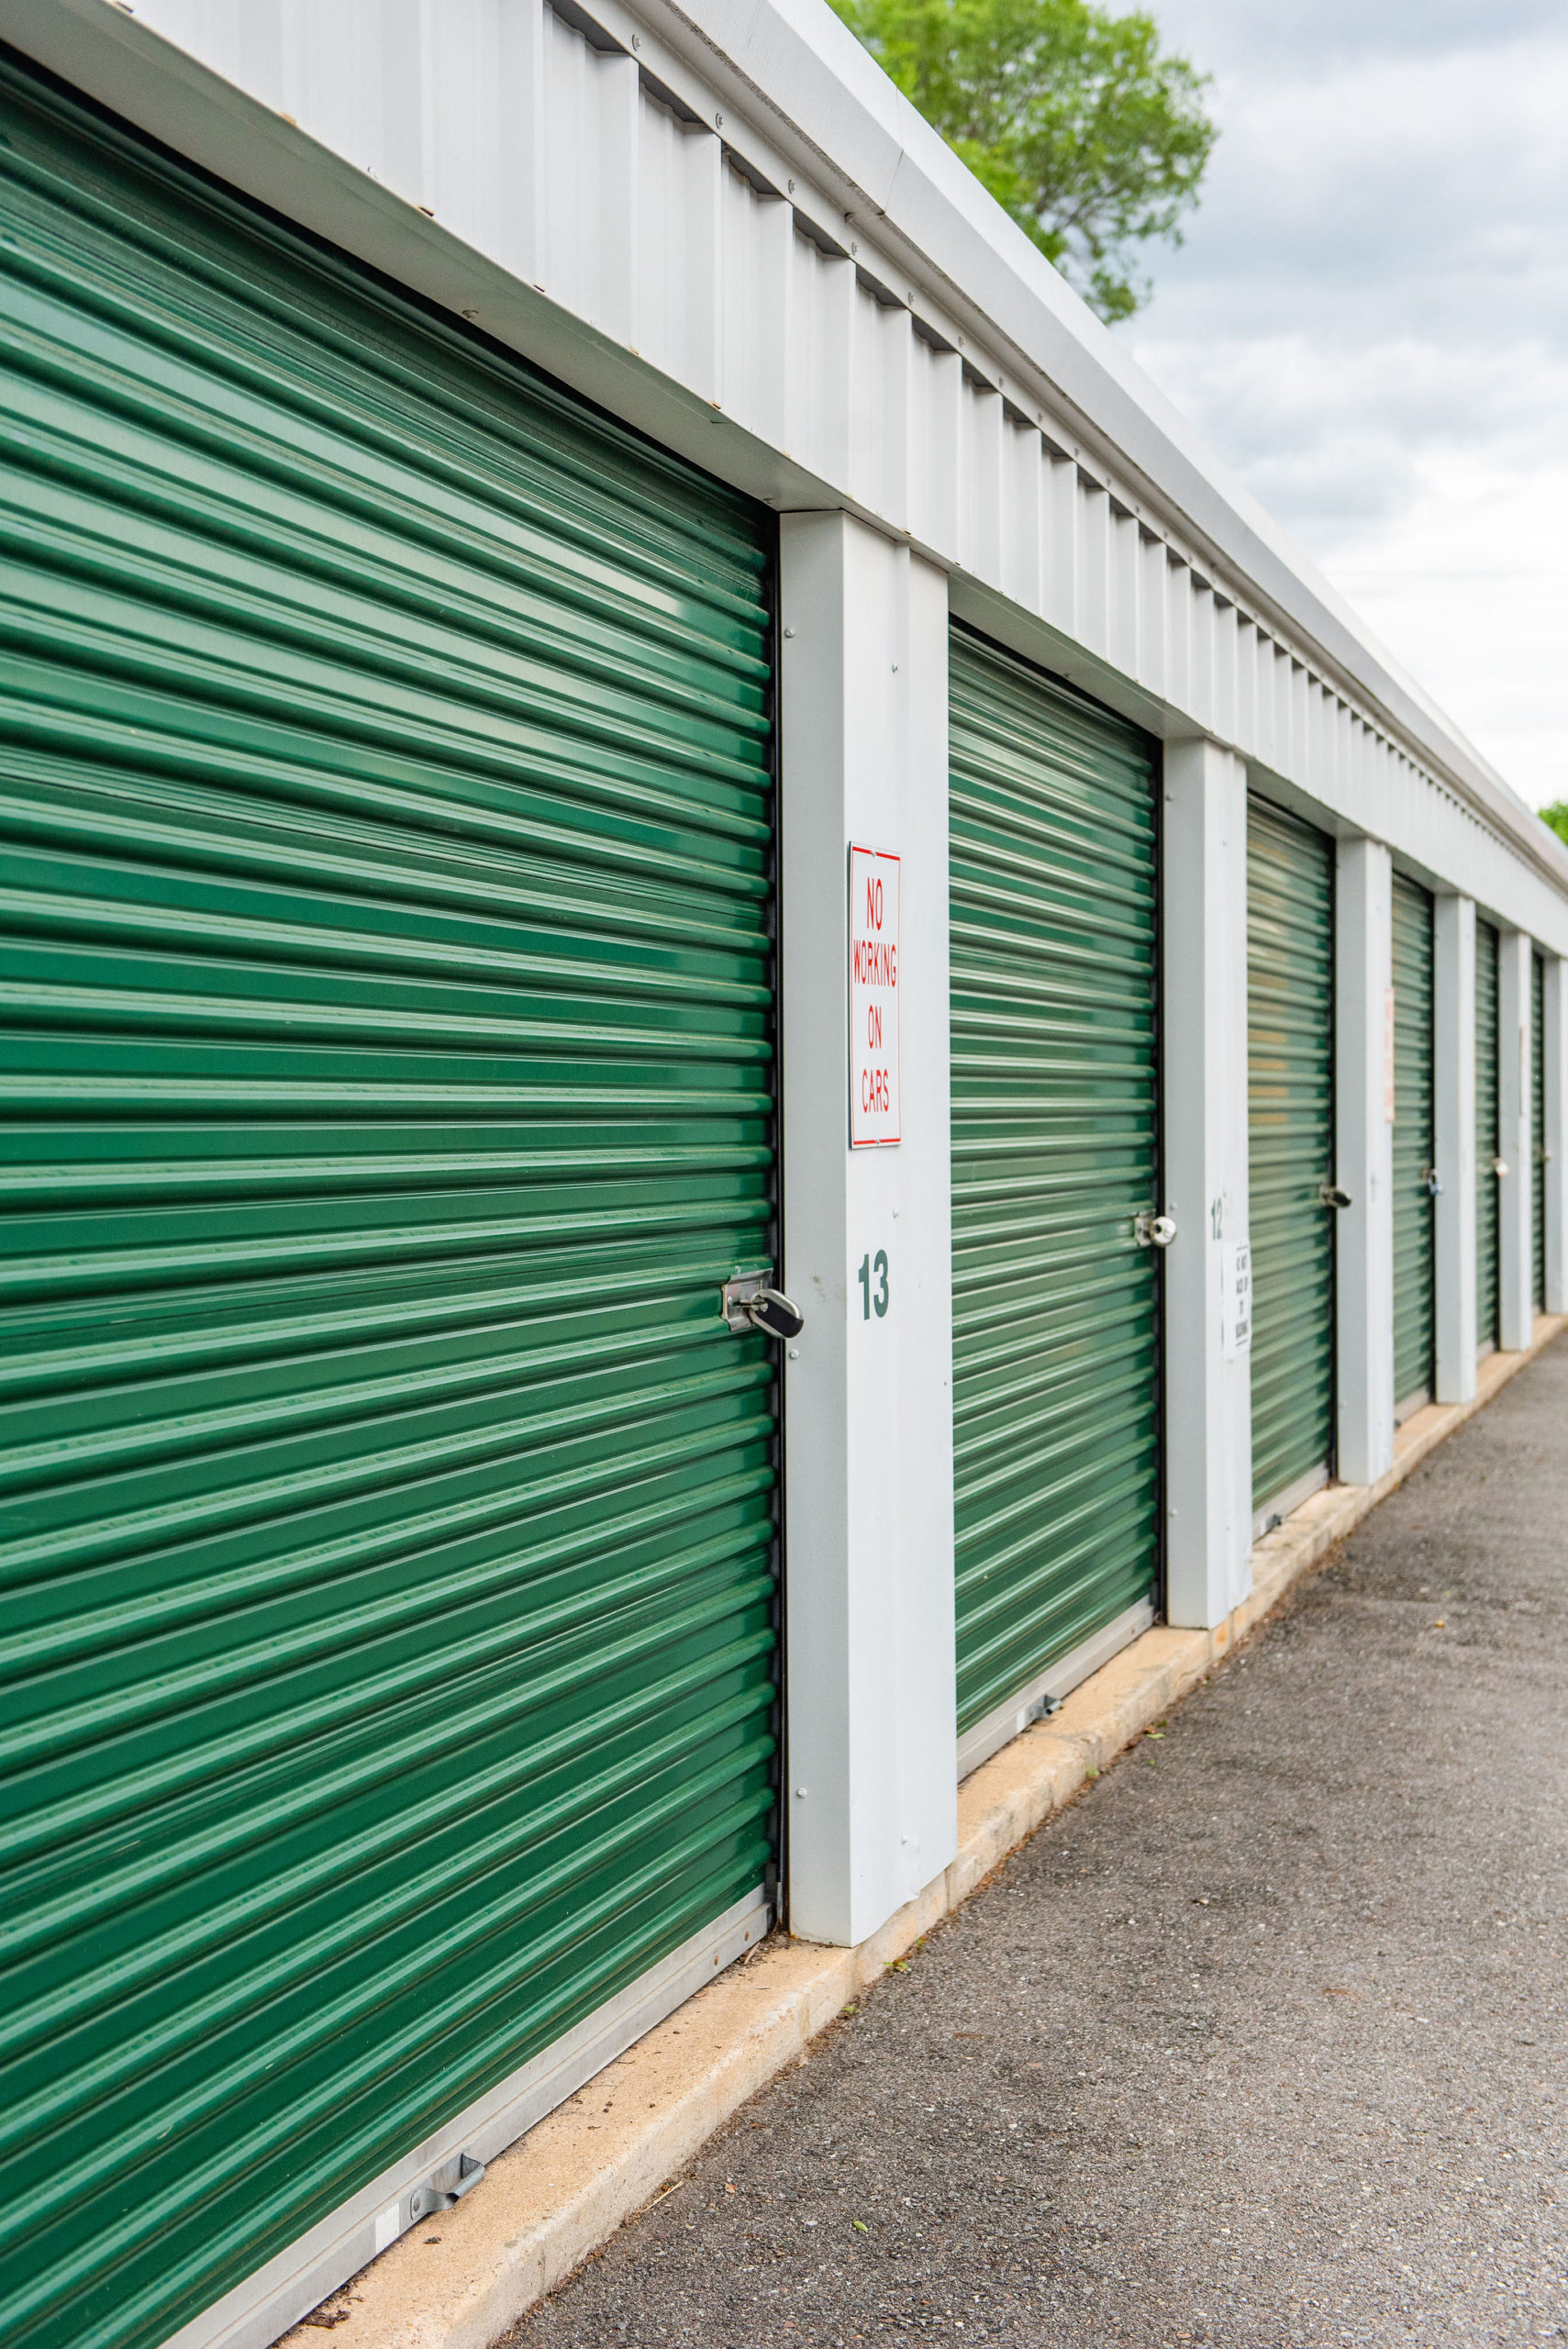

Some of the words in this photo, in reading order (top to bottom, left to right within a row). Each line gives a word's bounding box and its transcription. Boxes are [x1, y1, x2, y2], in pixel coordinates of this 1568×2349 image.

[866, 877, 883, 930] NO
[853, 940, 896, 987] WORKING
[868, 1005, 882, 1049] ON
[862, 1069, 889, 1113] CARS
[1211, 1197, 1223, 1241] 12
[858, 1249, 889, 1320] 13
